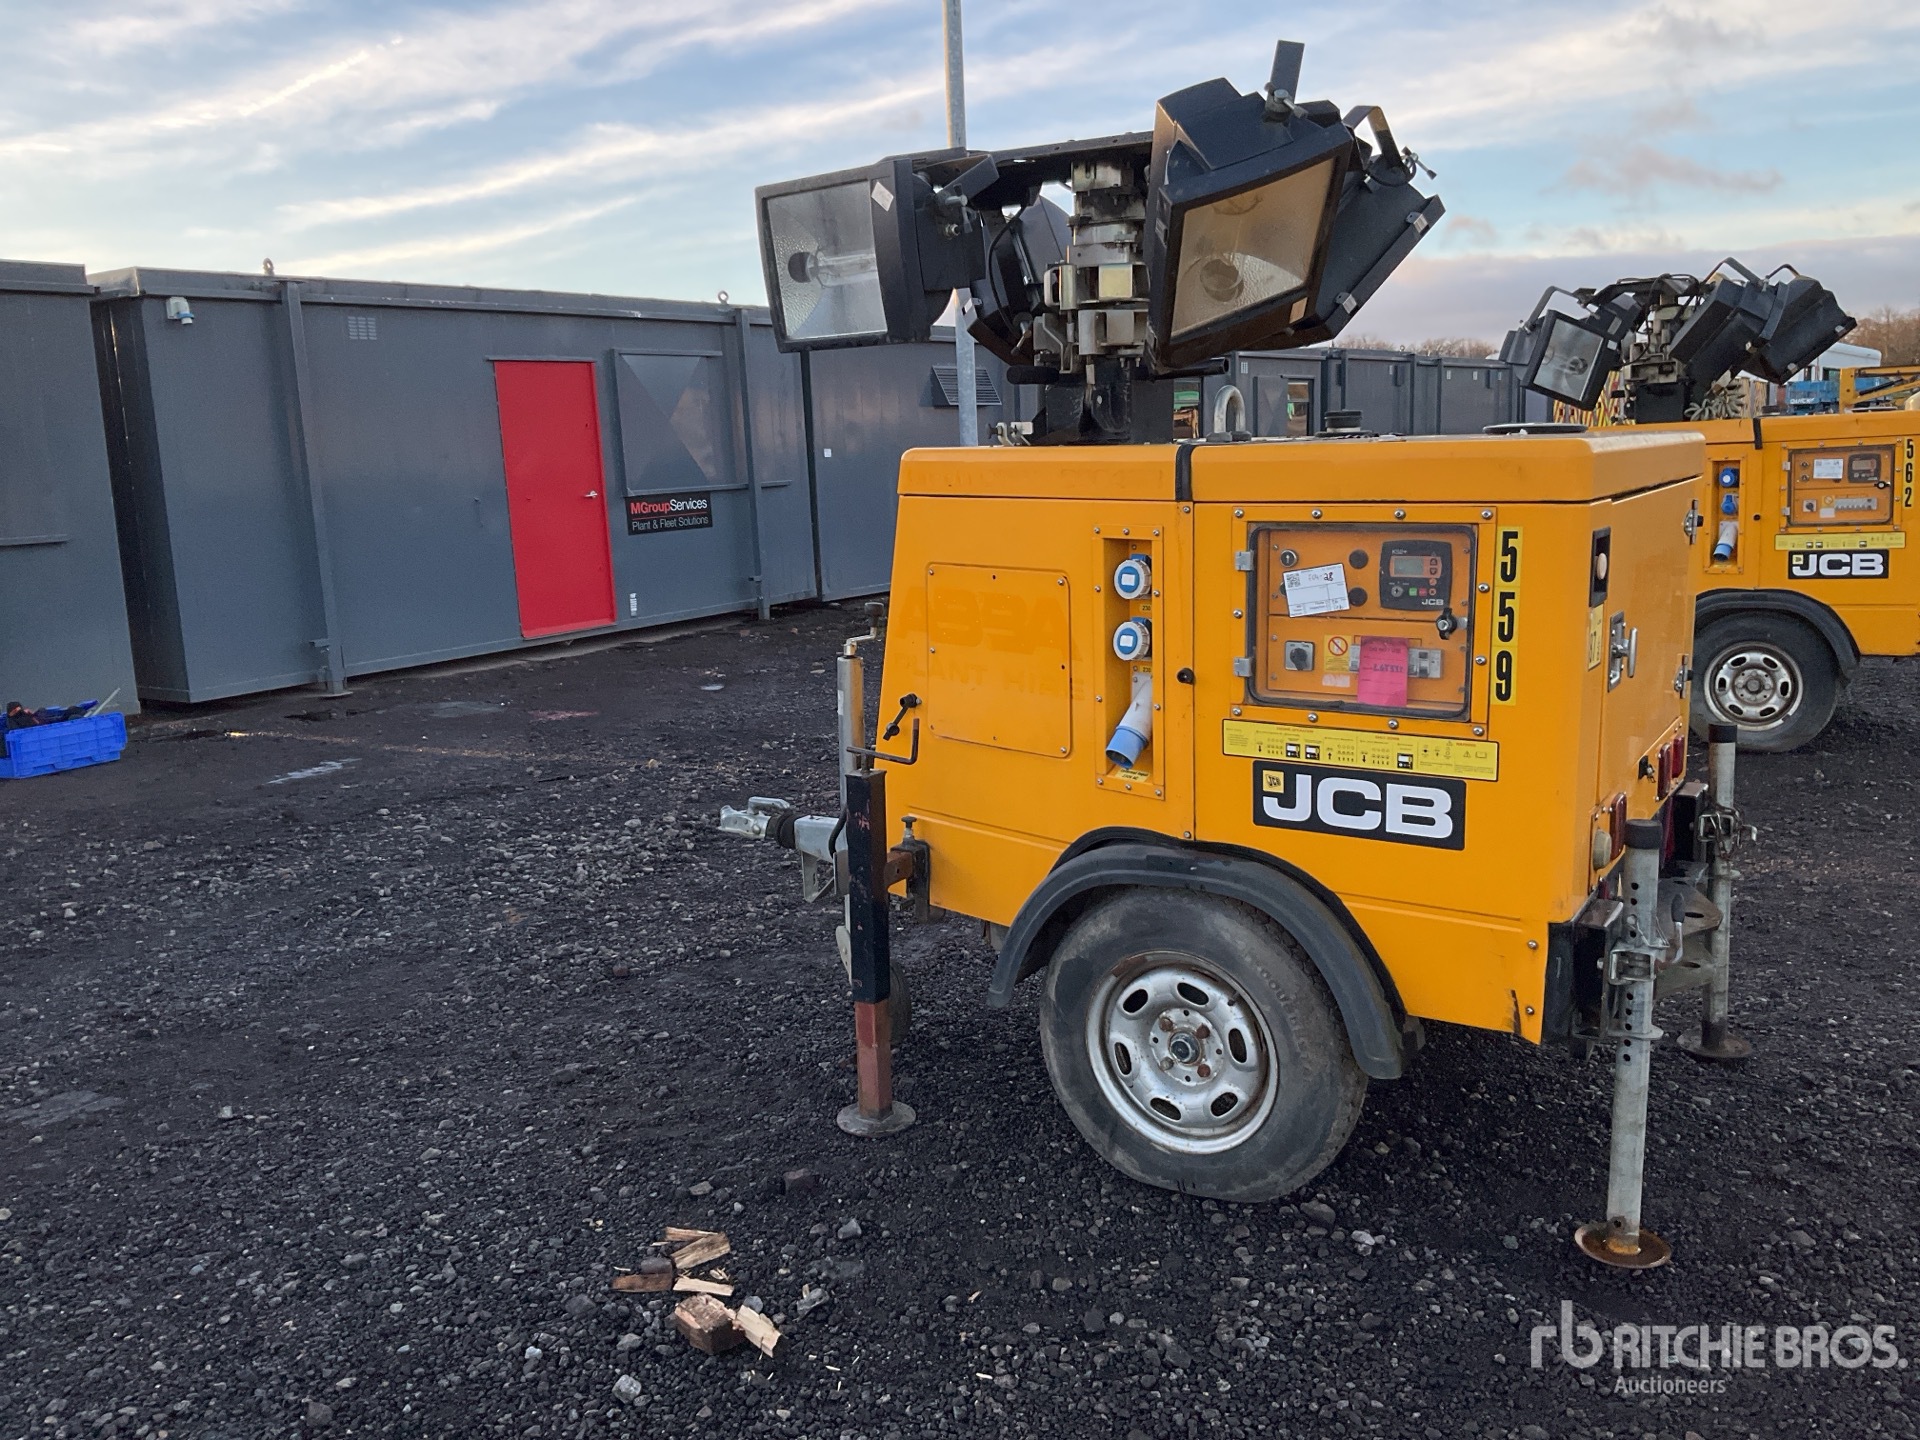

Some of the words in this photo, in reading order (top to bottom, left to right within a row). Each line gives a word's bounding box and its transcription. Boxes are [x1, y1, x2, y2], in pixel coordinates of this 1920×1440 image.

[1904, 439, 1914, 507] 562
[630, 498, 708, 515] MGroupServices
[632, 520, 651, 531] Plant
[653, 520, 658, 529] &
[660, 518, 677, 529] Fleet
[679, 516, 709, 527] Solutions
[1792, 553, 1884, 576] JCB
[1421, 598, 1444, 606] JCB
[1495, 531, 1519, 702] 559
[1262, 773, 1453, 839] JCB
